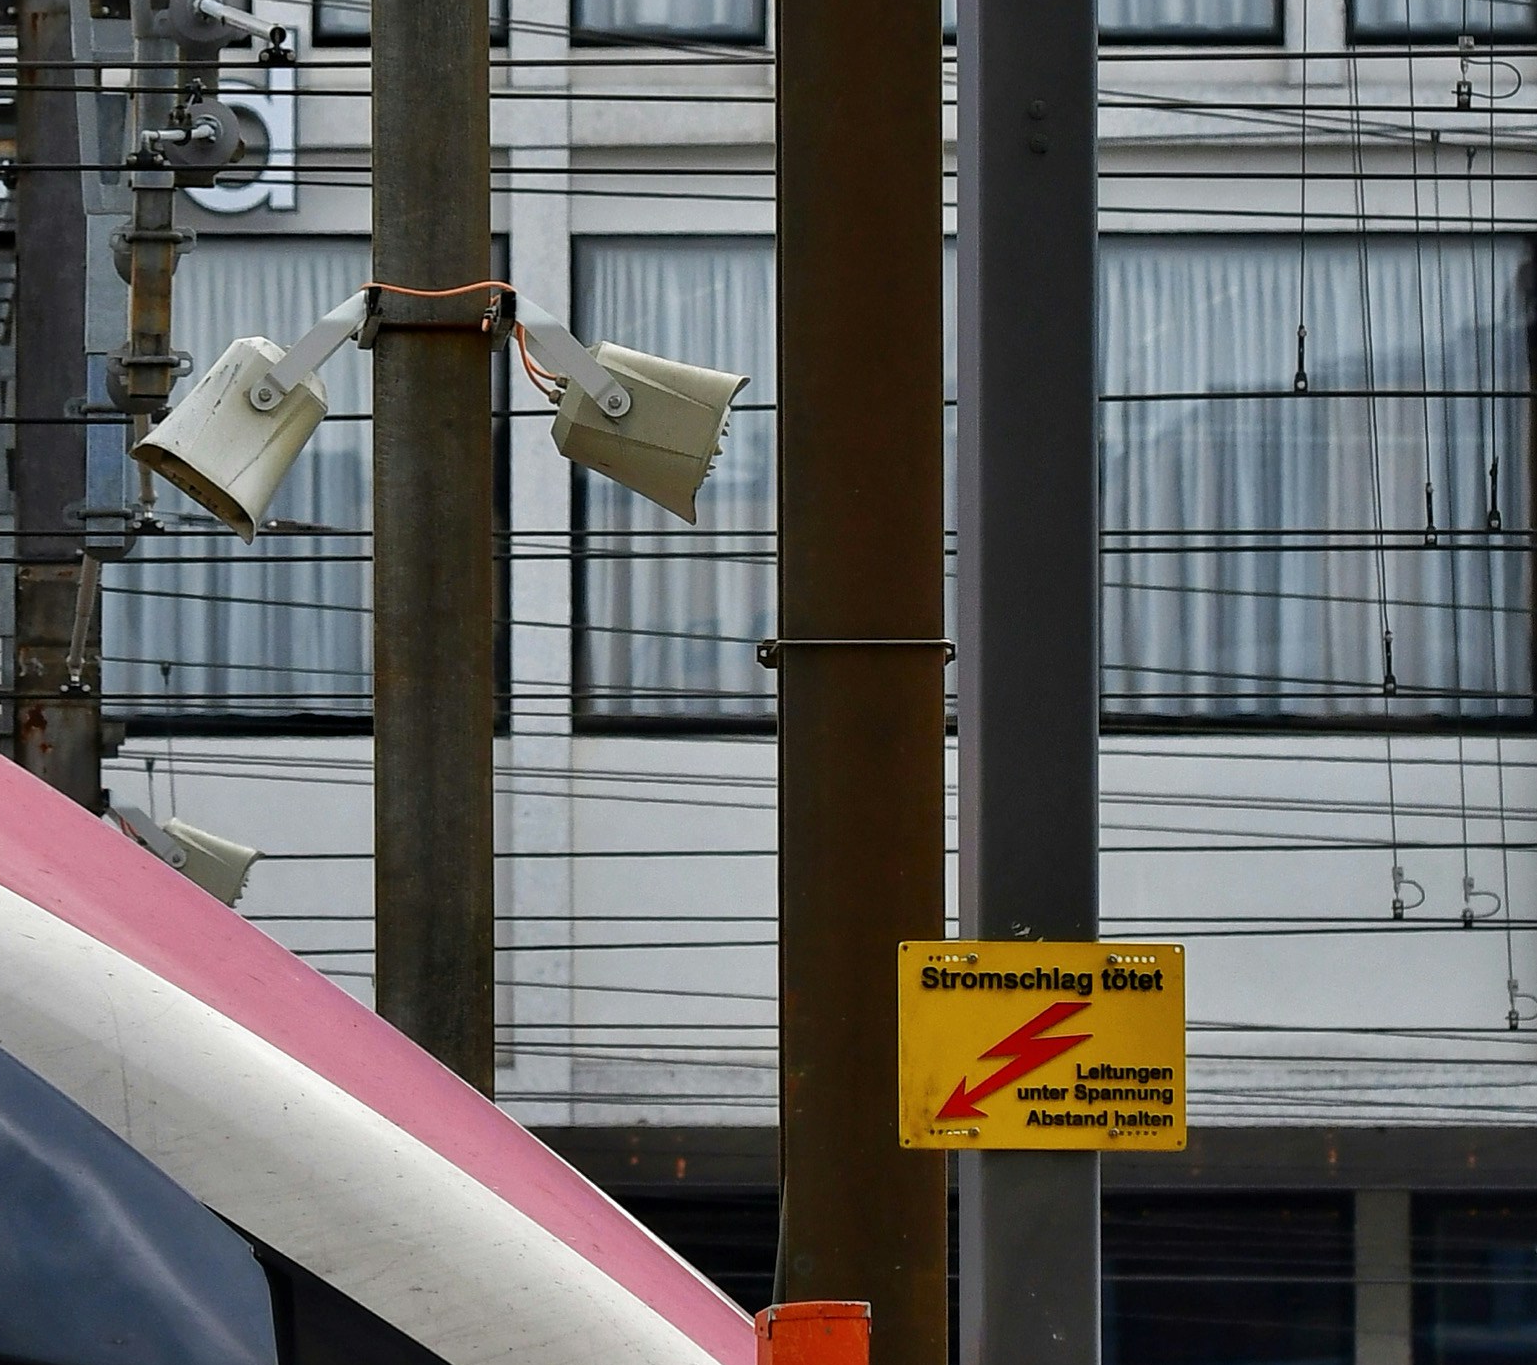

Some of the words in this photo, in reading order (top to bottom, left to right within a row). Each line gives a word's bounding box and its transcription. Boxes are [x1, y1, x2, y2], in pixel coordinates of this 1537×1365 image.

[921, 966, 1093, 996] Stromschlag
[1101, 966, 1164, 992] tötet
[1076, 1064, 1173, 1082] Leitungen
[1017, 1085, 1069, 1100] unter
[1074, 1084, 1174, 1104] Spannung
[1026, 1109, 1108, 1126] Abstand
[1115, 1110, 1174, 1126] halten
